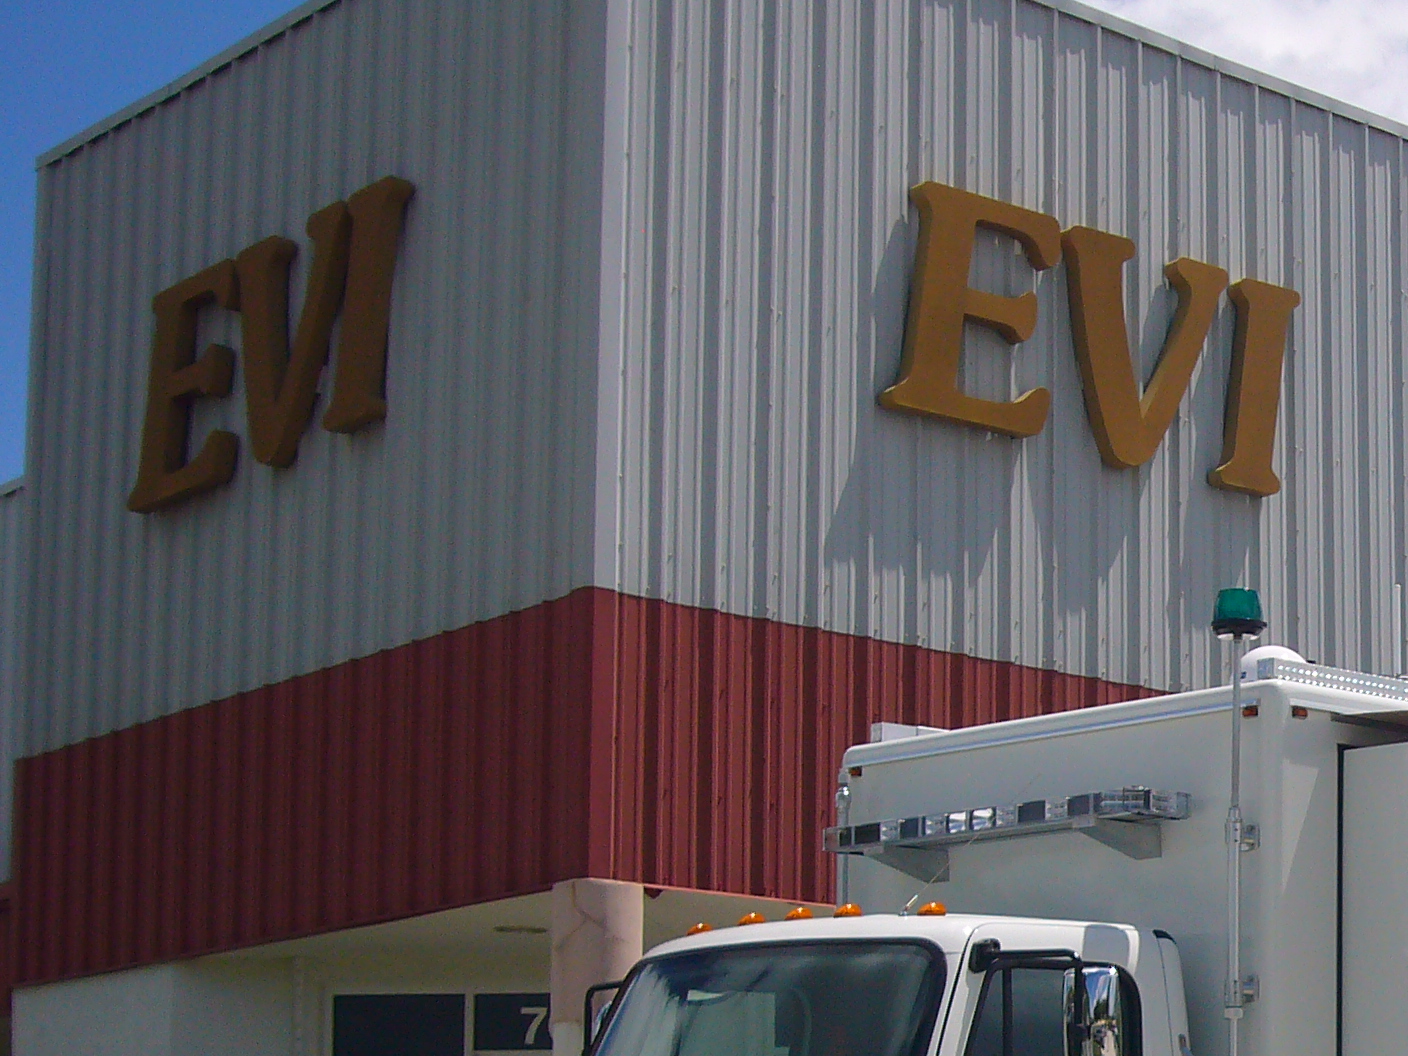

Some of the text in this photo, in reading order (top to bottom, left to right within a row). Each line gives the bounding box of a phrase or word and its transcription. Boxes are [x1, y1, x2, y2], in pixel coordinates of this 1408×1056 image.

[128, 175, 415, 513] EVI
[879, 180, 1300, 497] EVI
[520, 1006, 551, 1045] 7
